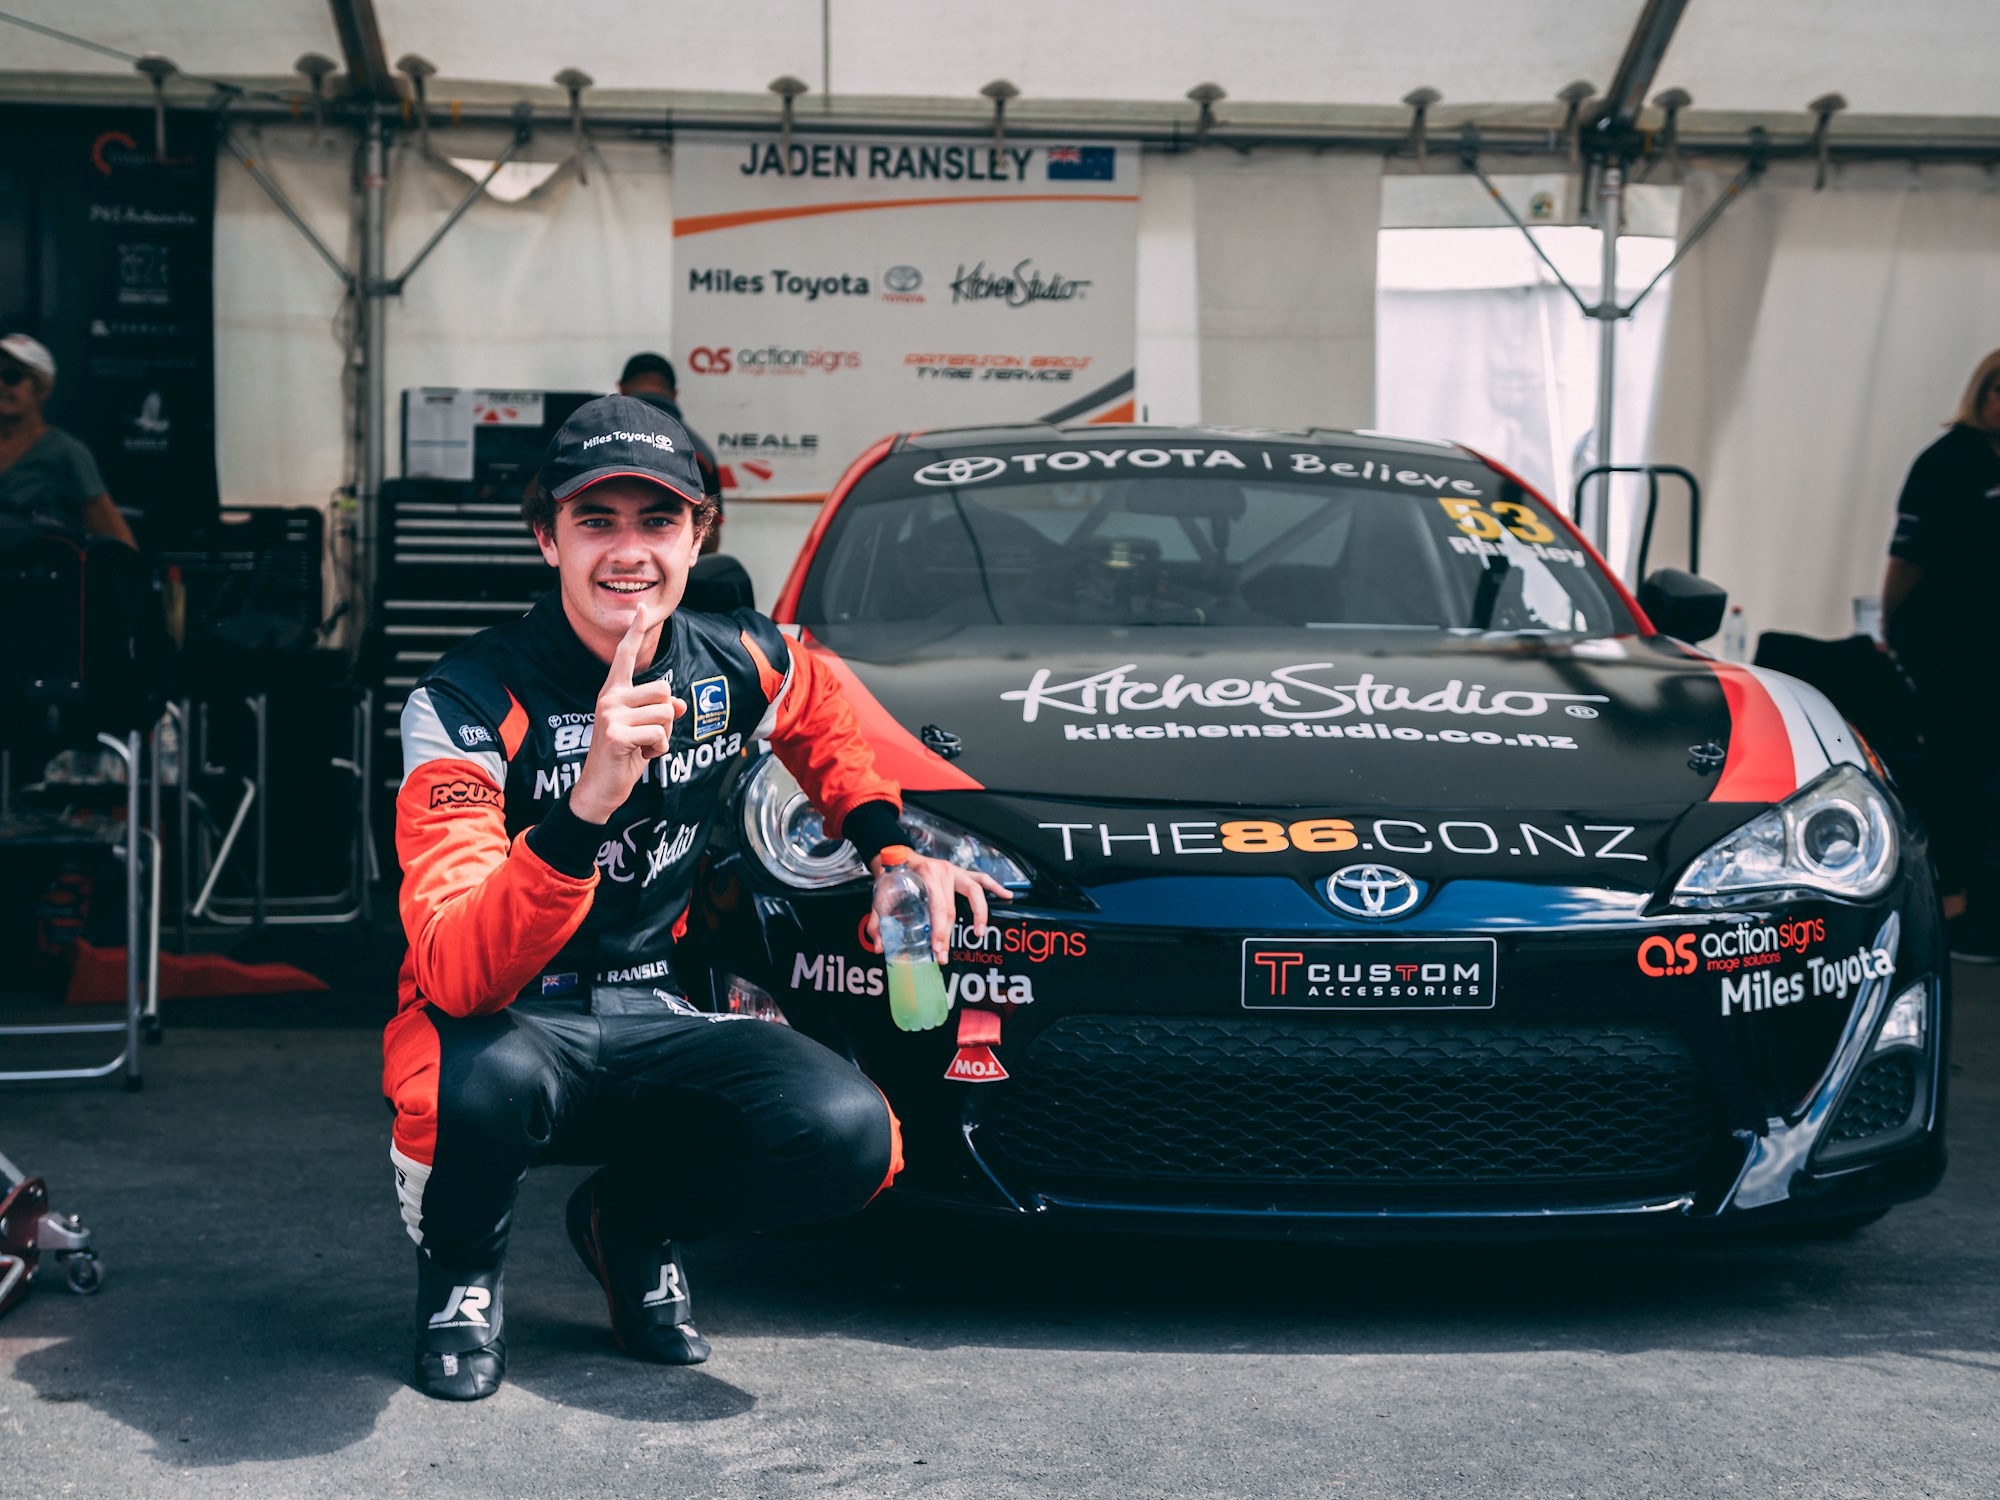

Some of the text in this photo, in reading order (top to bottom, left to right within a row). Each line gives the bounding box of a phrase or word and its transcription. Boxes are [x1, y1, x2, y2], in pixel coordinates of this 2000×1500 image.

[741, 143, 1034, 181] JADEN RANSLEY
[688, 268, 870, 301] Miles Toyota
[916, 366, 1075, 382] TYRE SERVICE
[583, 430, 653, 450] Miles Toyota
[717, 433, 820, 448] NEALE
[1011, 448, 1484, 496] TOYOTA Believe
[1438, 497, 1555, 544] 53
[561, 712, 596, 726] TOYO
[1063, 721, 1579, 750] kitchenstudio.co.nz
[533, 732, 742, 800] Mil Toyota
[429, 780, 503, 810] ROUX
[1037, 818, 1649, 862] THE86.CO.NZ
[606, 959, 670, 984] RANSLEY
[953, 950, 1004, 966] solutions
[1706, 951, 1782, 973] image solutions
[790, 952, 1035, 1011] Miles yota
[1307, 963, 1481, 983] CUSTOM
[1721, 945, 1897, 1017] Miles Toyota
[1307, 985, 1480, 997] ACCESSORIES
[954, 1058, 1000, 1077] TOW
[428, 1285, 492, 1325] JR
